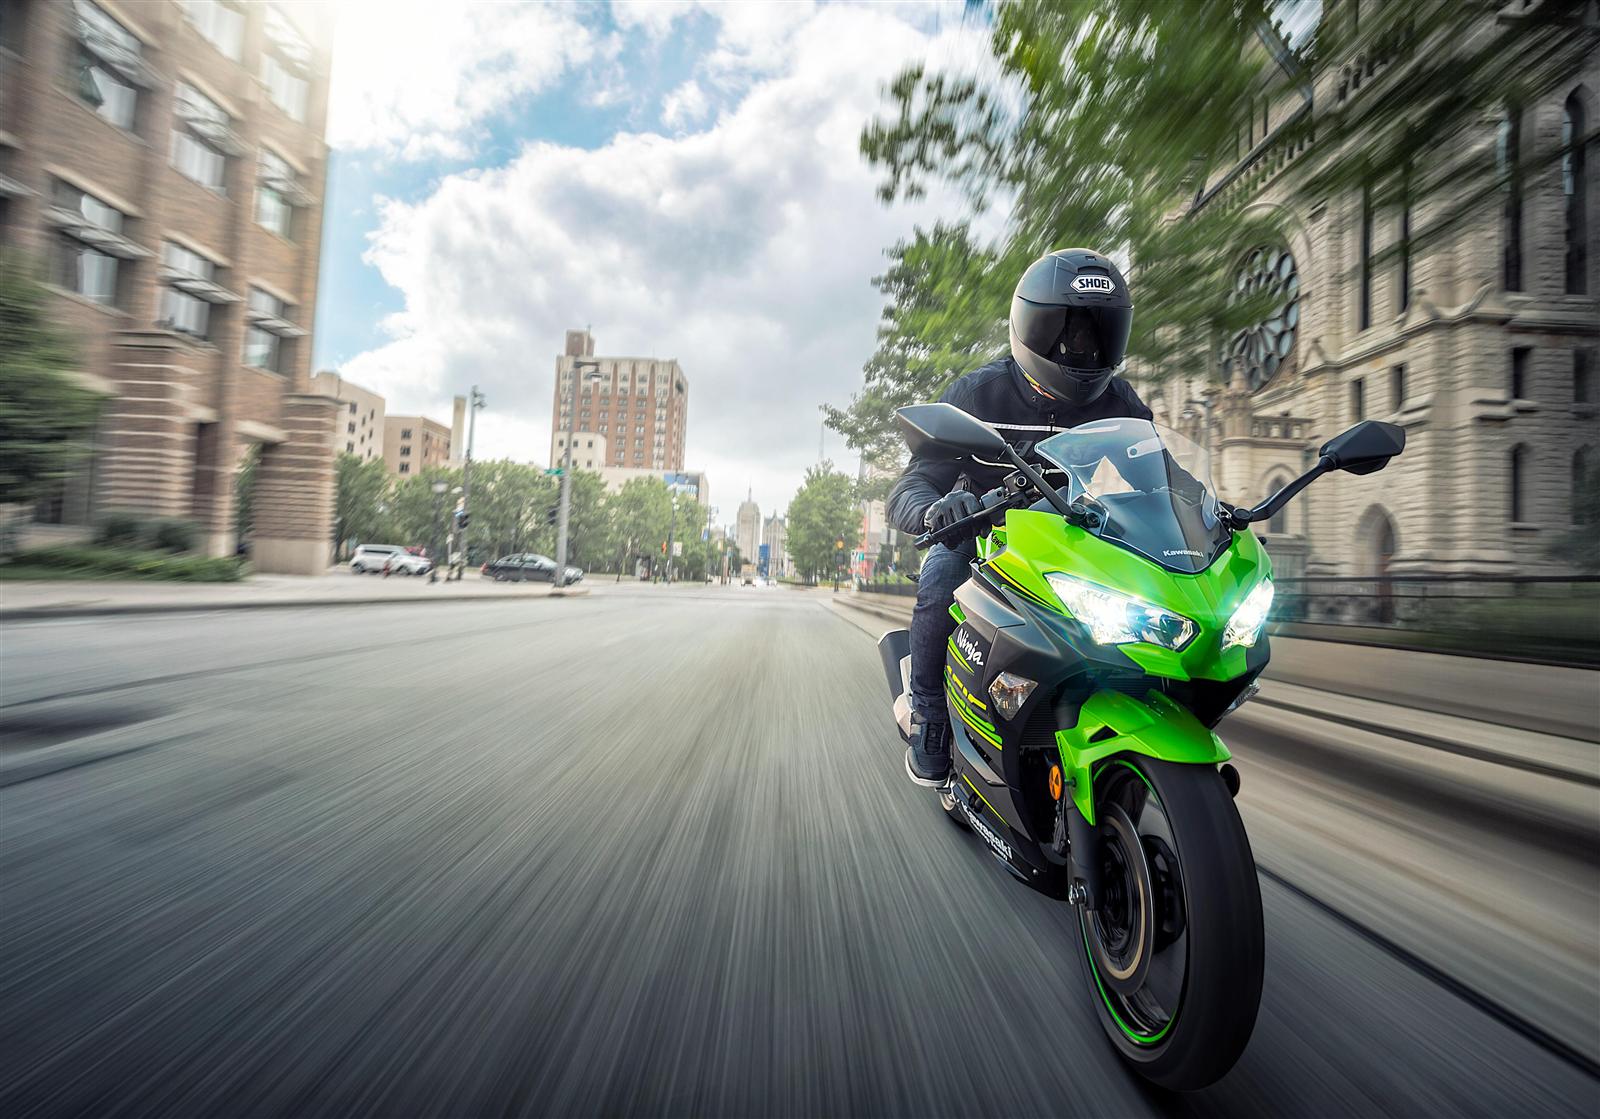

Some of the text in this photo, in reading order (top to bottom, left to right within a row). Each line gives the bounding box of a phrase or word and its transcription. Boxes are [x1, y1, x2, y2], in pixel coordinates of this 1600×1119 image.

[1078, 279, 1110, 290] SHOEI
[1162, 549, 1204, 558] Kawasaki
[957, 628, 984, 666] Ninja
